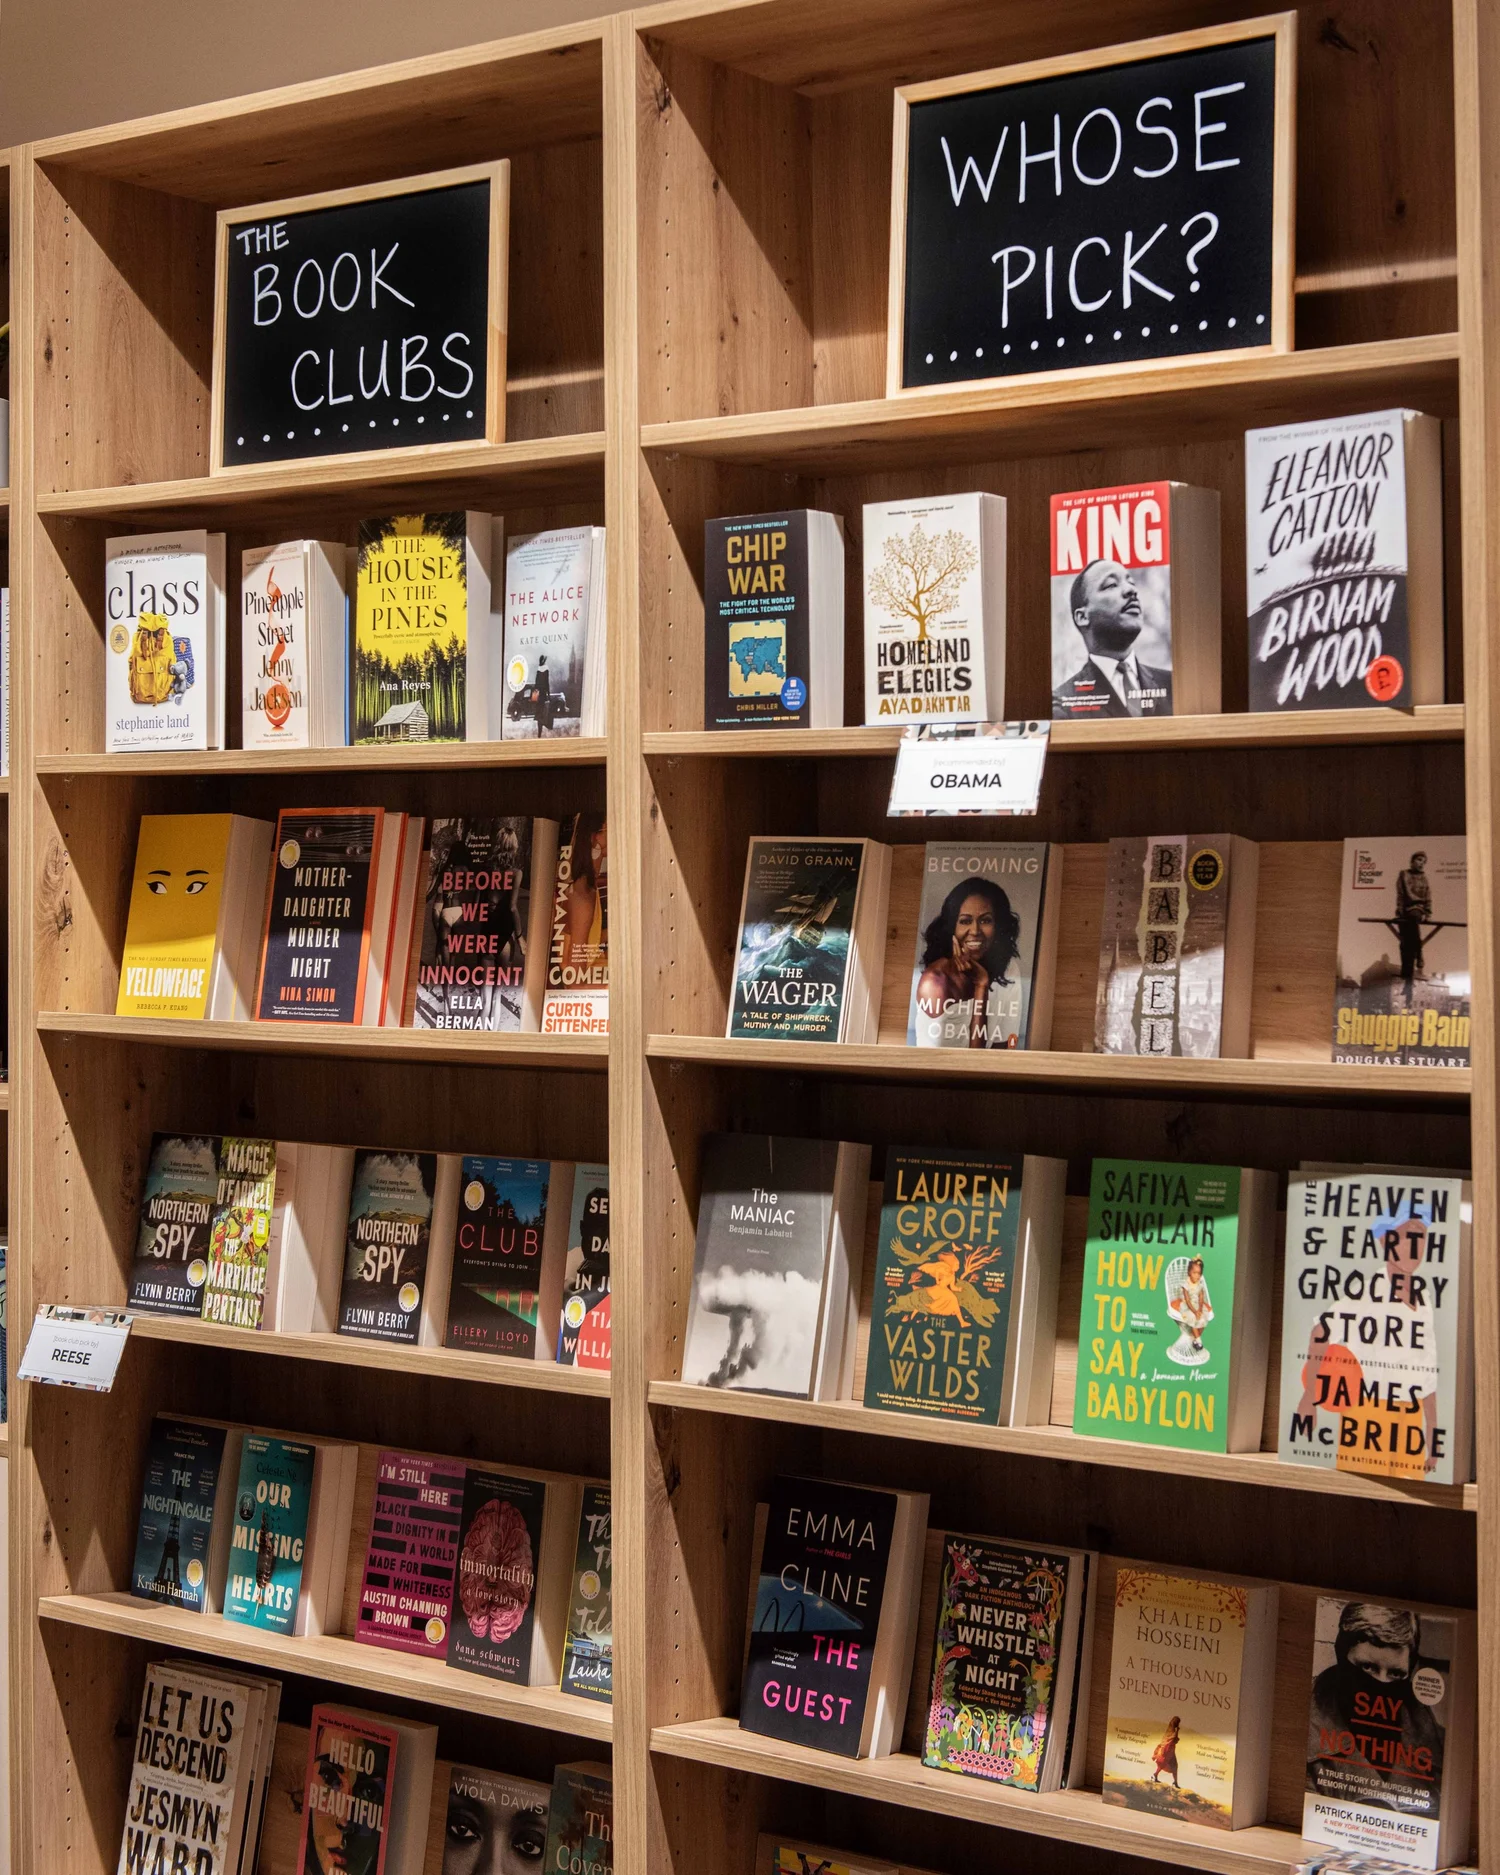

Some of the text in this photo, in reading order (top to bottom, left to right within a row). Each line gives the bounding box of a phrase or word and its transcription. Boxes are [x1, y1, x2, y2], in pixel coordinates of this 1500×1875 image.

[941, 81, 1246, 206] WHOSE
[236, 221, 289, 256] THE
[254, 242, 415, 326] BOOK
[991, 211, 1219, 328] PICK?
[291, 332, 474, 410] CLUBS
[1260, 432, 1394, 514] ELEANOR
[1268, 481, 1380, 557] CATTON
[392, 538, 426, 555] THE
[727, 531, 787, 564] CHIP
[1056, 499, 1162, 571] KING
[368, 556, 453, 584] HOUSE
[728, 564, 786, 595] WAR
[108, 570, 199, 620] class
[245, 586, 304, 619] Pineapple
[381, 584, 437, 603] IN THE
[510, 585, 584, 606] THE ALICE
[731, 600, 746, 608] FIGHT
[771, 596, 795, 604] WORLD'S
[372, 604, 448, 631] PINES
[512, 608, 580, 628] NETWORK
[1258, 577, 1396, 662] BIRNAM
[258, 621, 294, 647] Street
[878, 637, 970, 667] HOMELAND
[1277, 624, 1383, 705] WOOD
[258, 654, 294, 680] Jenny
[878, 666, 972, 695] ELEGIES
[250, 687, 302, 712] Jackson
[379, 680, 432, 692] Ana Reyes
[878, 694, 970, 716] AYAD AKHTAR
[116, 713, 190, 733] stephanie land
[930, 774, 1002, 788] OBAMA
[758, 855, 854, 866] DAVID GRANN
[928, 856, 1039, 874] BECOMING
[294, 867, 352, 887] MOTHER-
[442, 872, 514, 891] BEFORE
[284, 898, 351, 918] DAUGHTER
[462, 903, 489, 922] WE
[288, 928, 340, 948] MURDER
[447, 934, 499, 954] WERE
[126, 967, 206, 998] YELLOWFACE
[290, 958, 331, 979] NIGHT
[420, 966, 523, 986] INNOCENT
[779, 968, 803, 978] THE
[280, 986, 336, 1003] NINA SIMON
[450, 996, 484, 1010] ELLA
[740, 980, 838, 1008] WAGER
[916, 998, 1020, 1017] MICHELLE
[436, 1014, 494, 1030] BERMAN
[546, 1002, 593, 1017] CURTIS
[785, 1013, 832, 1022] SHIPWRECK,
[744, 1022, 826, 1032] MUTINY AND MURDER
[928, 1023, 1003, 1041] OBAMA
[1336, 1008, 1471, 1052] Shuggie Bain
[226, 1144, 270, 1176] MAGGIE
[216, 1179, 271, 1210] O'FARRELL
[752, 1188, 778, 1204] The
[896, 1170, 1009, 1208] LAUREN
[1103, 1170, 1190, 1208] SAFIYA
[1304, 1180, 1448, 1222] THE HEAVEN
[149, 1198, 210, 1224] NORTHERN
[488, 1206, 514, 1220] THE
[730, 1205, 796, 1226] MANIAC
[896, 1205, 1002, 1243] GROFF
[154, 1222, 196, 1261] SPY
[459, 1223, 538, 1256] CLUB
[1100, 1210, 1214, 1248] SINCLAIR
[1302, 1225, 1446, 1263] & EARTH
[206, 1260, 266, 1296] MARRIAGE
[1096, 1250, 1164, 1291] HOW
[134, 1282, 198, 1304] FLYNN BERRY
[1298, 1264, 1449, 1308] GROCERY
[204, 1292, 262, 1328] PORTRAIT
[930, 1317, 946, 1328] THE
[1094, 1294, 1127, 1333] TO
[454, 1325, 530, 1344] ELLERY LLOYD
[1314, 1312, 1425, 1350] STORE
[51, 1348, 92, 1366] REESE
[884, 1324, 992, 1368] VASTER
[1090, 1338, 1144, 1379] SAY
[889, 1360, 980, 1402] WILDS
[1312, 1374, 1424, 1414] JAMES
[1086, 1380, 1214, 1433] BABYLON
[1289, 1412, 1447, 1458] McBRIDE
[172, 1468, 192, 1488] THE
[143, 1494, 212, 1523] NIGHTINGALE
[256, 1480, 292, 1509] OUR
[376, 1500, 407, 1518] BLACK
[420, 1489, 448, 1506] HERE
[787, 1508, 876, 1550] EMMA
[368, 1554, 419, 1576] MADE FOR
[459, 1552, 535, 1594] immortality
[137, 1574, 198, 1603] Kristin Hannah
[232, 1574, 293, 1612] HEARTS
[392, 1577, 451, 1600] WHITENESS
[780, 1564, 870, 1607] CLINE
[363, 1590, 448, 1618] AUSTIN CHANNING
[970, 1604, 1028, 1632] NEVER
[374, 1610, 410, 1628] BROWN
[1138, 1606, 1222, 1634] KHALED
[812, 1634, 860, 1670] THE
[957, 1624, 1036, 1656] WHISTLE
[1136, 1626, 1220, 1654] HOSSEINI
[988, 1654, 1000, 1665] AT
[1126, 1656, 1228, 1686] A THOUSAND
[965, 1664, 1019, 1692] NIGHT
[762, 1680, 852, 1724] GUEST
[1120, 1676, 1232, 1710] SPLENDID SUNS
[1354, 1692, 1403, 1721] SAY
[144, 1682, 192, 1732] LET
[198, 1695, 234, 1744] US
[138, 1726, 228, 1784] DESCEND
[329, 1738, 375, 1776] HELLO
[1320, 1728, 1432, 1772] NOTHING
[308, 1783, 385, 1832] BEAUTIFUL
[454, 1782, 544, 1815] VIOLA DAVIS
[130, 1784, 221, 1844] JESMYN
[1314, 1804, 1428, 1838] PATRICK RADDEN KEEFE
[1342, 1822, 1360, 1832] YORK
[1360, 1826, 1378, 1836] TIMES
[1380, 1830, 1417, 1845] BESTSELLER
